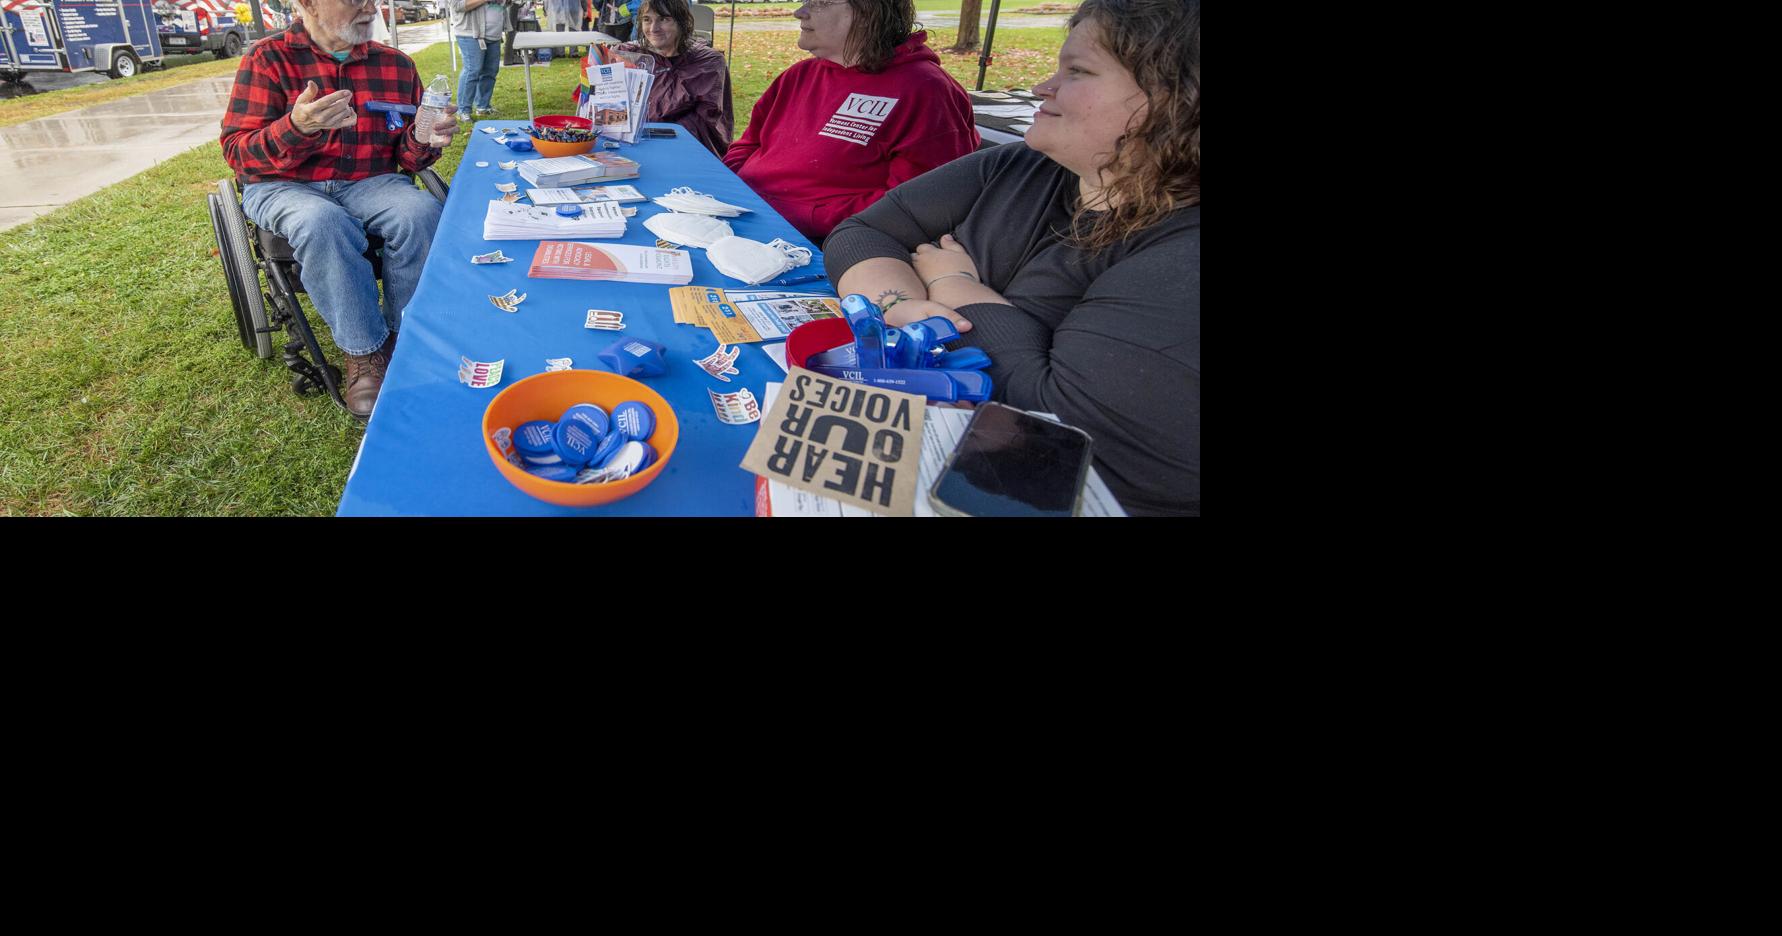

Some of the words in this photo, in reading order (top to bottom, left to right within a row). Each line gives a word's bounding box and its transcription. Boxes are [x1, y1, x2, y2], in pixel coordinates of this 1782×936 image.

[847, 97, 888, 116] VCIL
[830, 118, 850, 126] Vermont
[850, 121, 868, 130] Center
[853, 132, 870, 142] Living
[471, 363, 489, 386] LOVE
[843, 371, 864, 380] VCIL
[789, 375, 911, 431] VOICES
[566, 432, 587, 456] VCIL
[780, 403, 904, 463] OUR
[767, 435, 896, 507] HEAR
